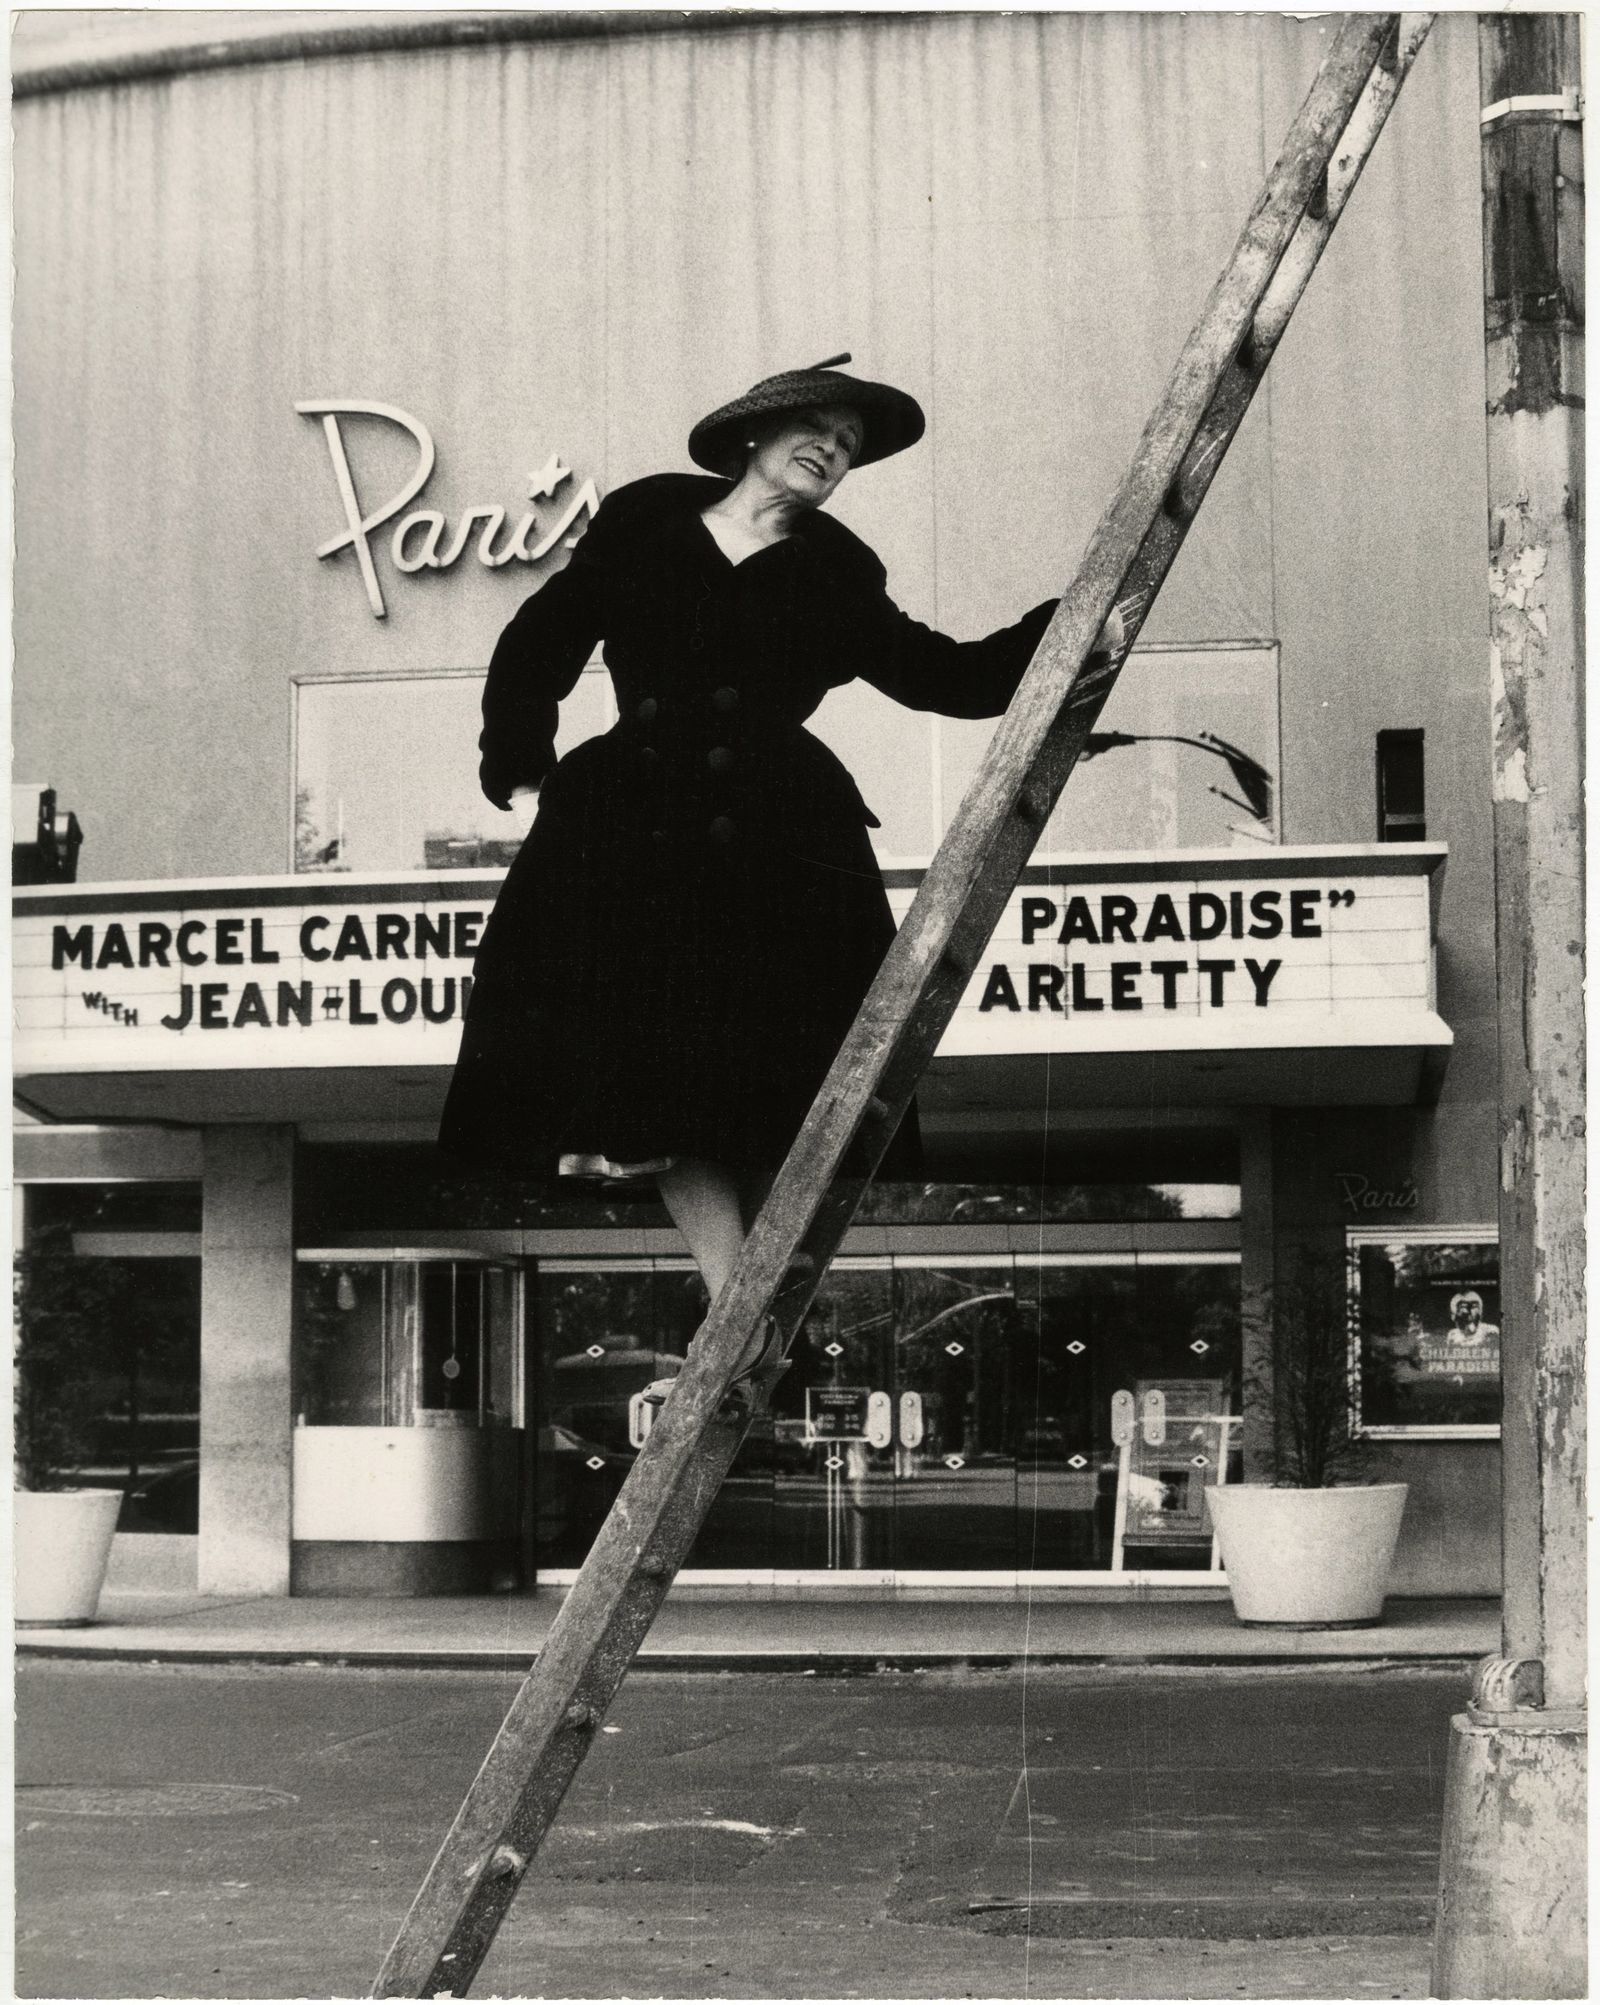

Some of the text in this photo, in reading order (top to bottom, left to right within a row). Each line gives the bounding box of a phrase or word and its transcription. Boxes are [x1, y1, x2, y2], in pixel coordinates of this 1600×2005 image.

[294, 399, 600, 620] Paris
[51, 918, 280, 970] MARCEL
[82, 991, 138, 1027] WITH
[979, 958, 1282, 1012] ARLETTY
[1333, 1172, 1419, 1213] Paris
